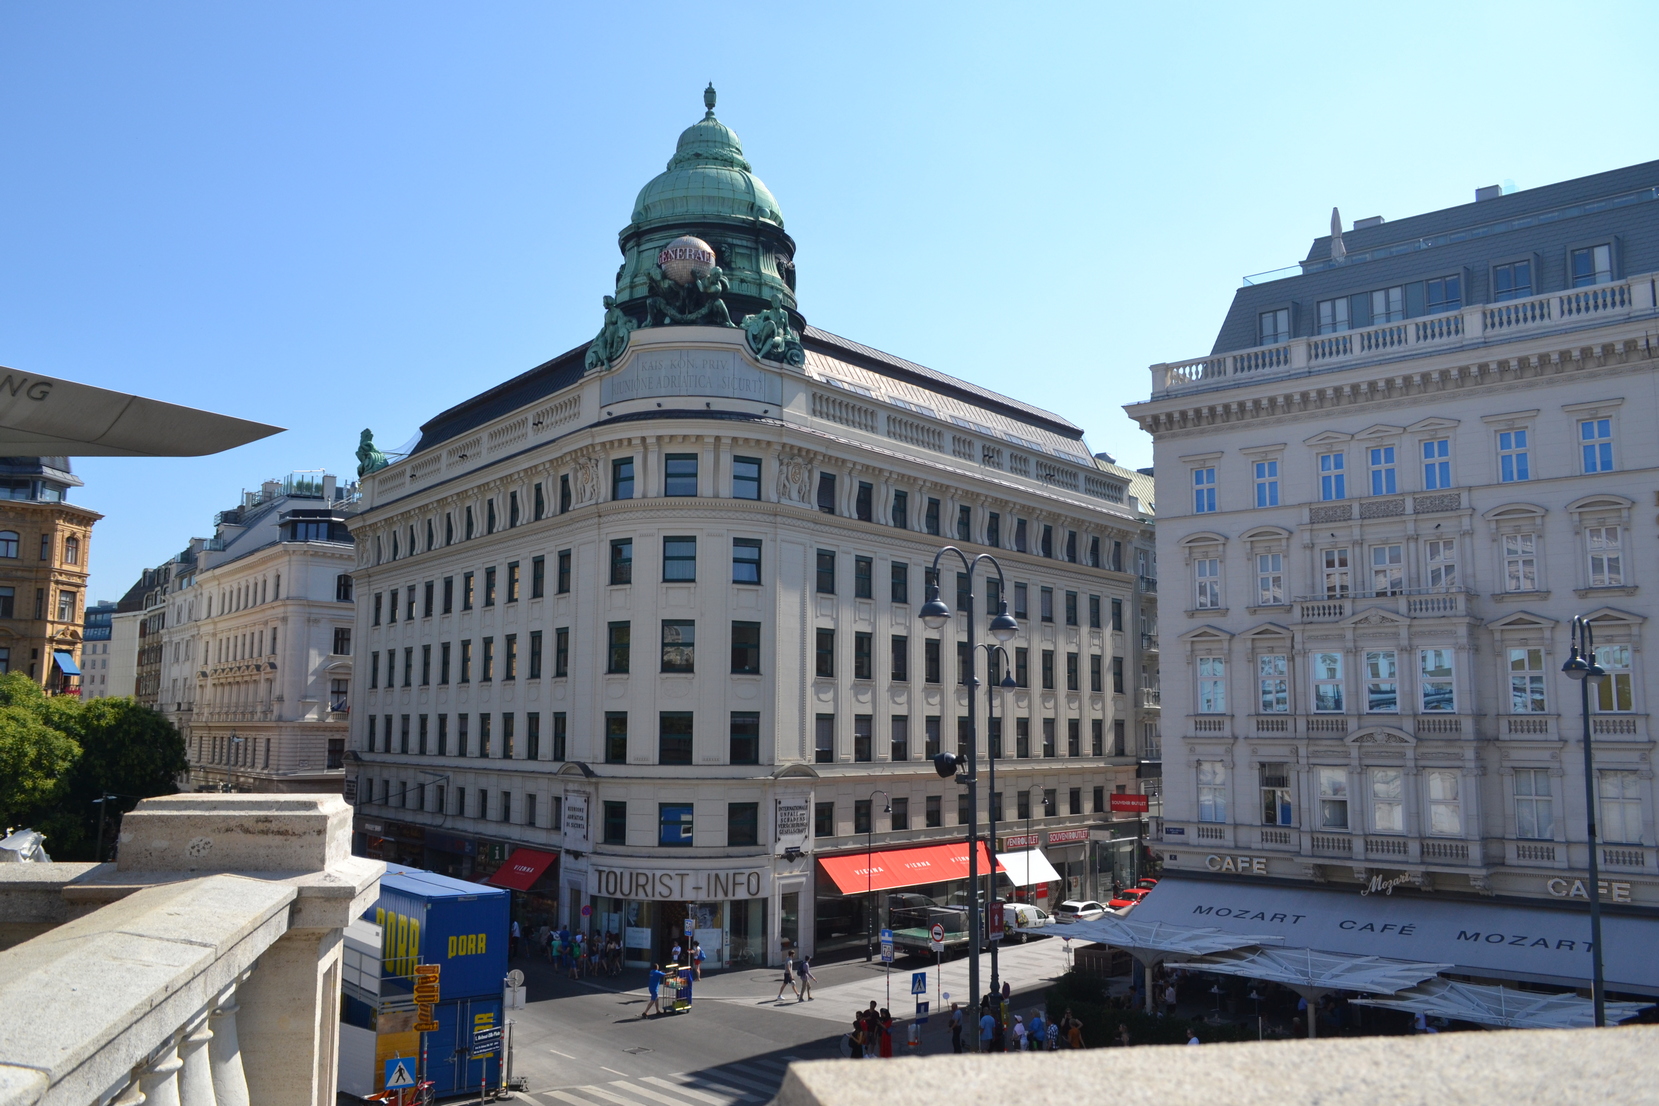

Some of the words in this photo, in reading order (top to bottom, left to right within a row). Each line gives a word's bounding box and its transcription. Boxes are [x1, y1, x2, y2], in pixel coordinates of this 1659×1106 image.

[658, 247, 712, 265] GENERALI
[702, 359, 729, 371] PRIV.
[656, 374, 713, 389] ADRIATICA
[904, 860, 931, 869] VIENNA
[950, 855, 970, 863] VIENN
[513, 864, 535, 873] VIENNA
[854, 866, 884, 876] VIENNA
[1360, 871, 1411, 897] Mozart
[1192, 905, 1306, 925] MOZART
[1339, 923, 1417, 937] CAFÉ
[448, 933, 487, 959] PORR
